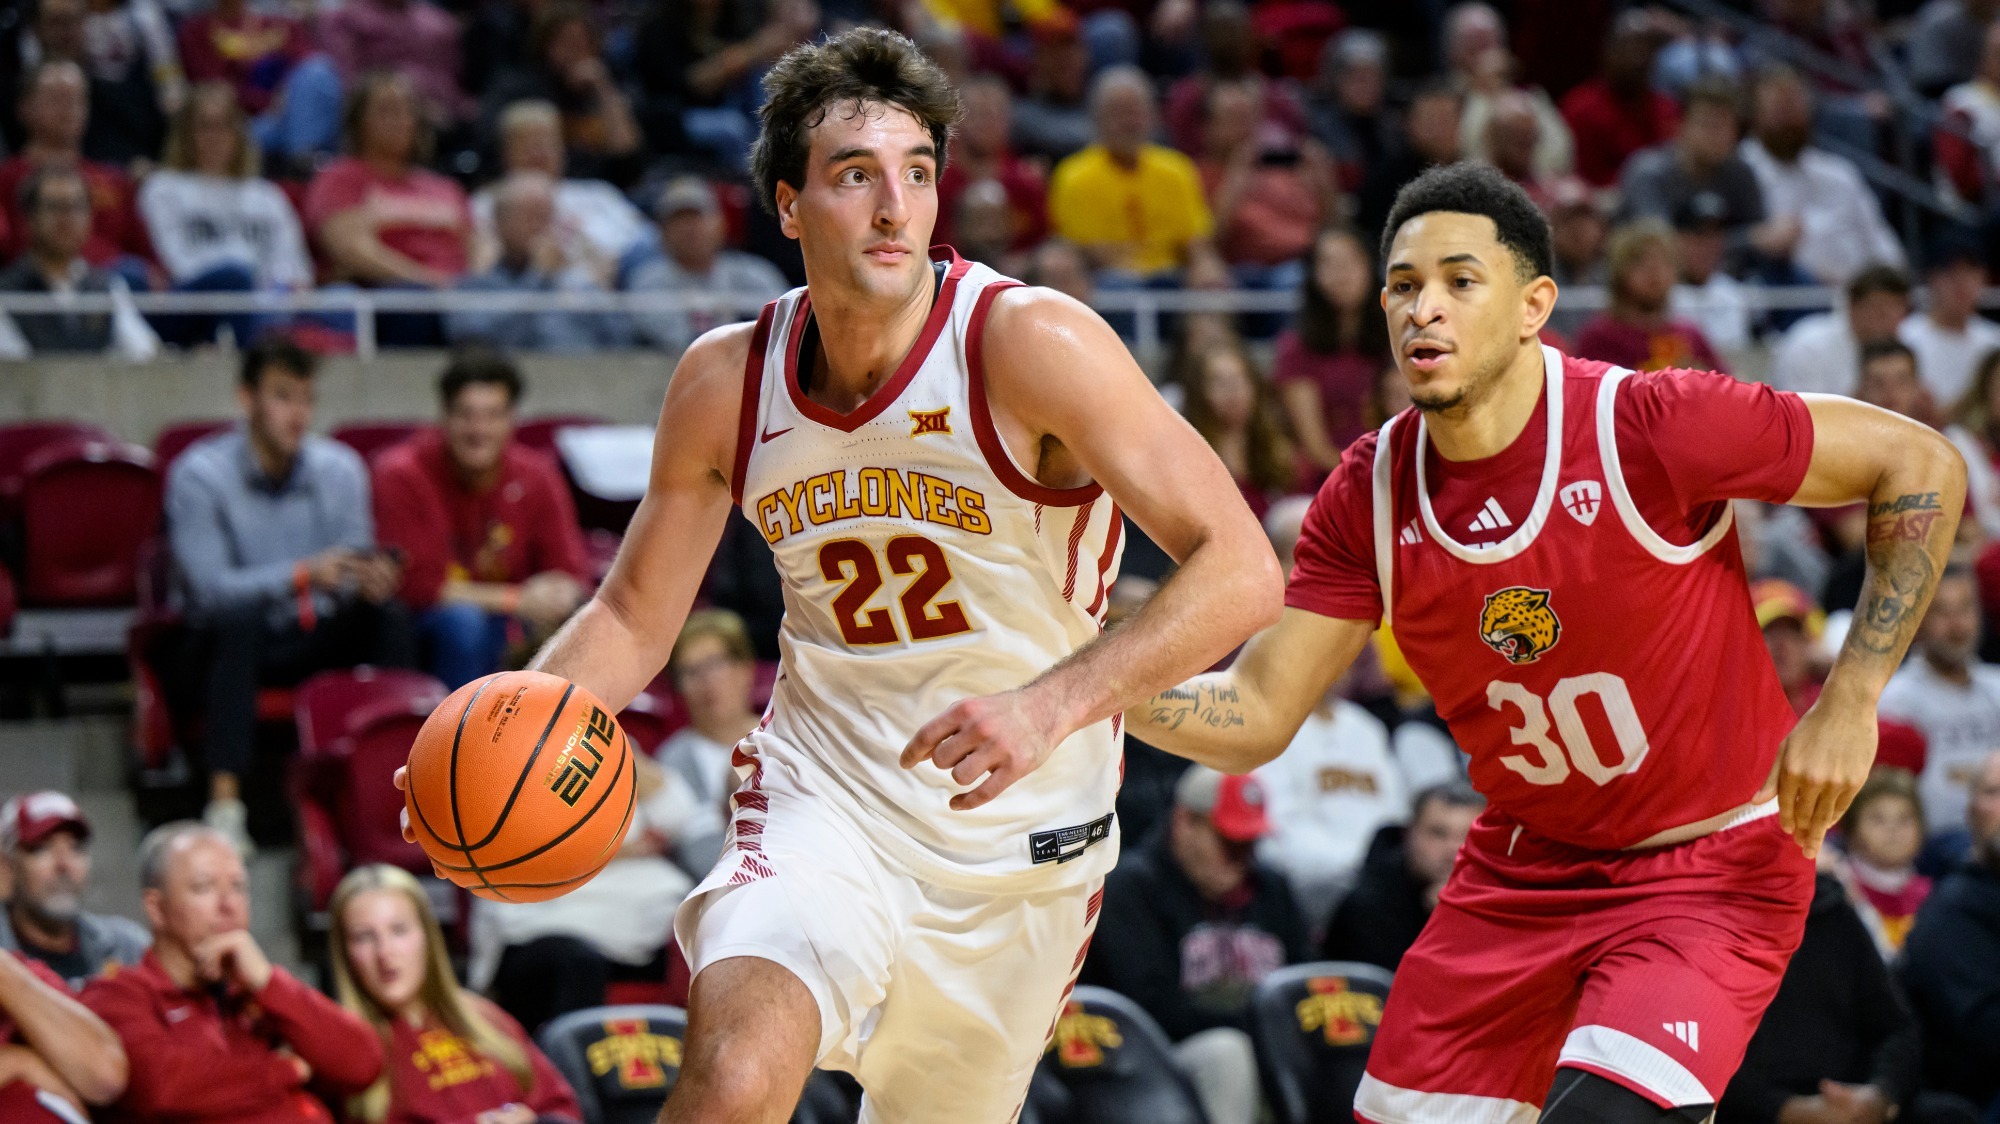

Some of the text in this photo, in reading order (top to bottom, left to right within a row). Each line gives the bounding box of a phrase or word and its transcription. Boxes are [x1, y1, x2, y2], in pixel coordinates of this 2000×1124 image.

[907, 406, 953, 439] XII
[757, 467, 992, 544] CYCLONES
[1869, 492, 1941, 516] UMBLE
[817, 533, 972, 646] 22
[1485, 671, 1649, 786] 30
[549, 704, 616, 809] ELITE
[1036, 848, 1057, 856] TEAM
[1091, 824, 1103, 838] 46
